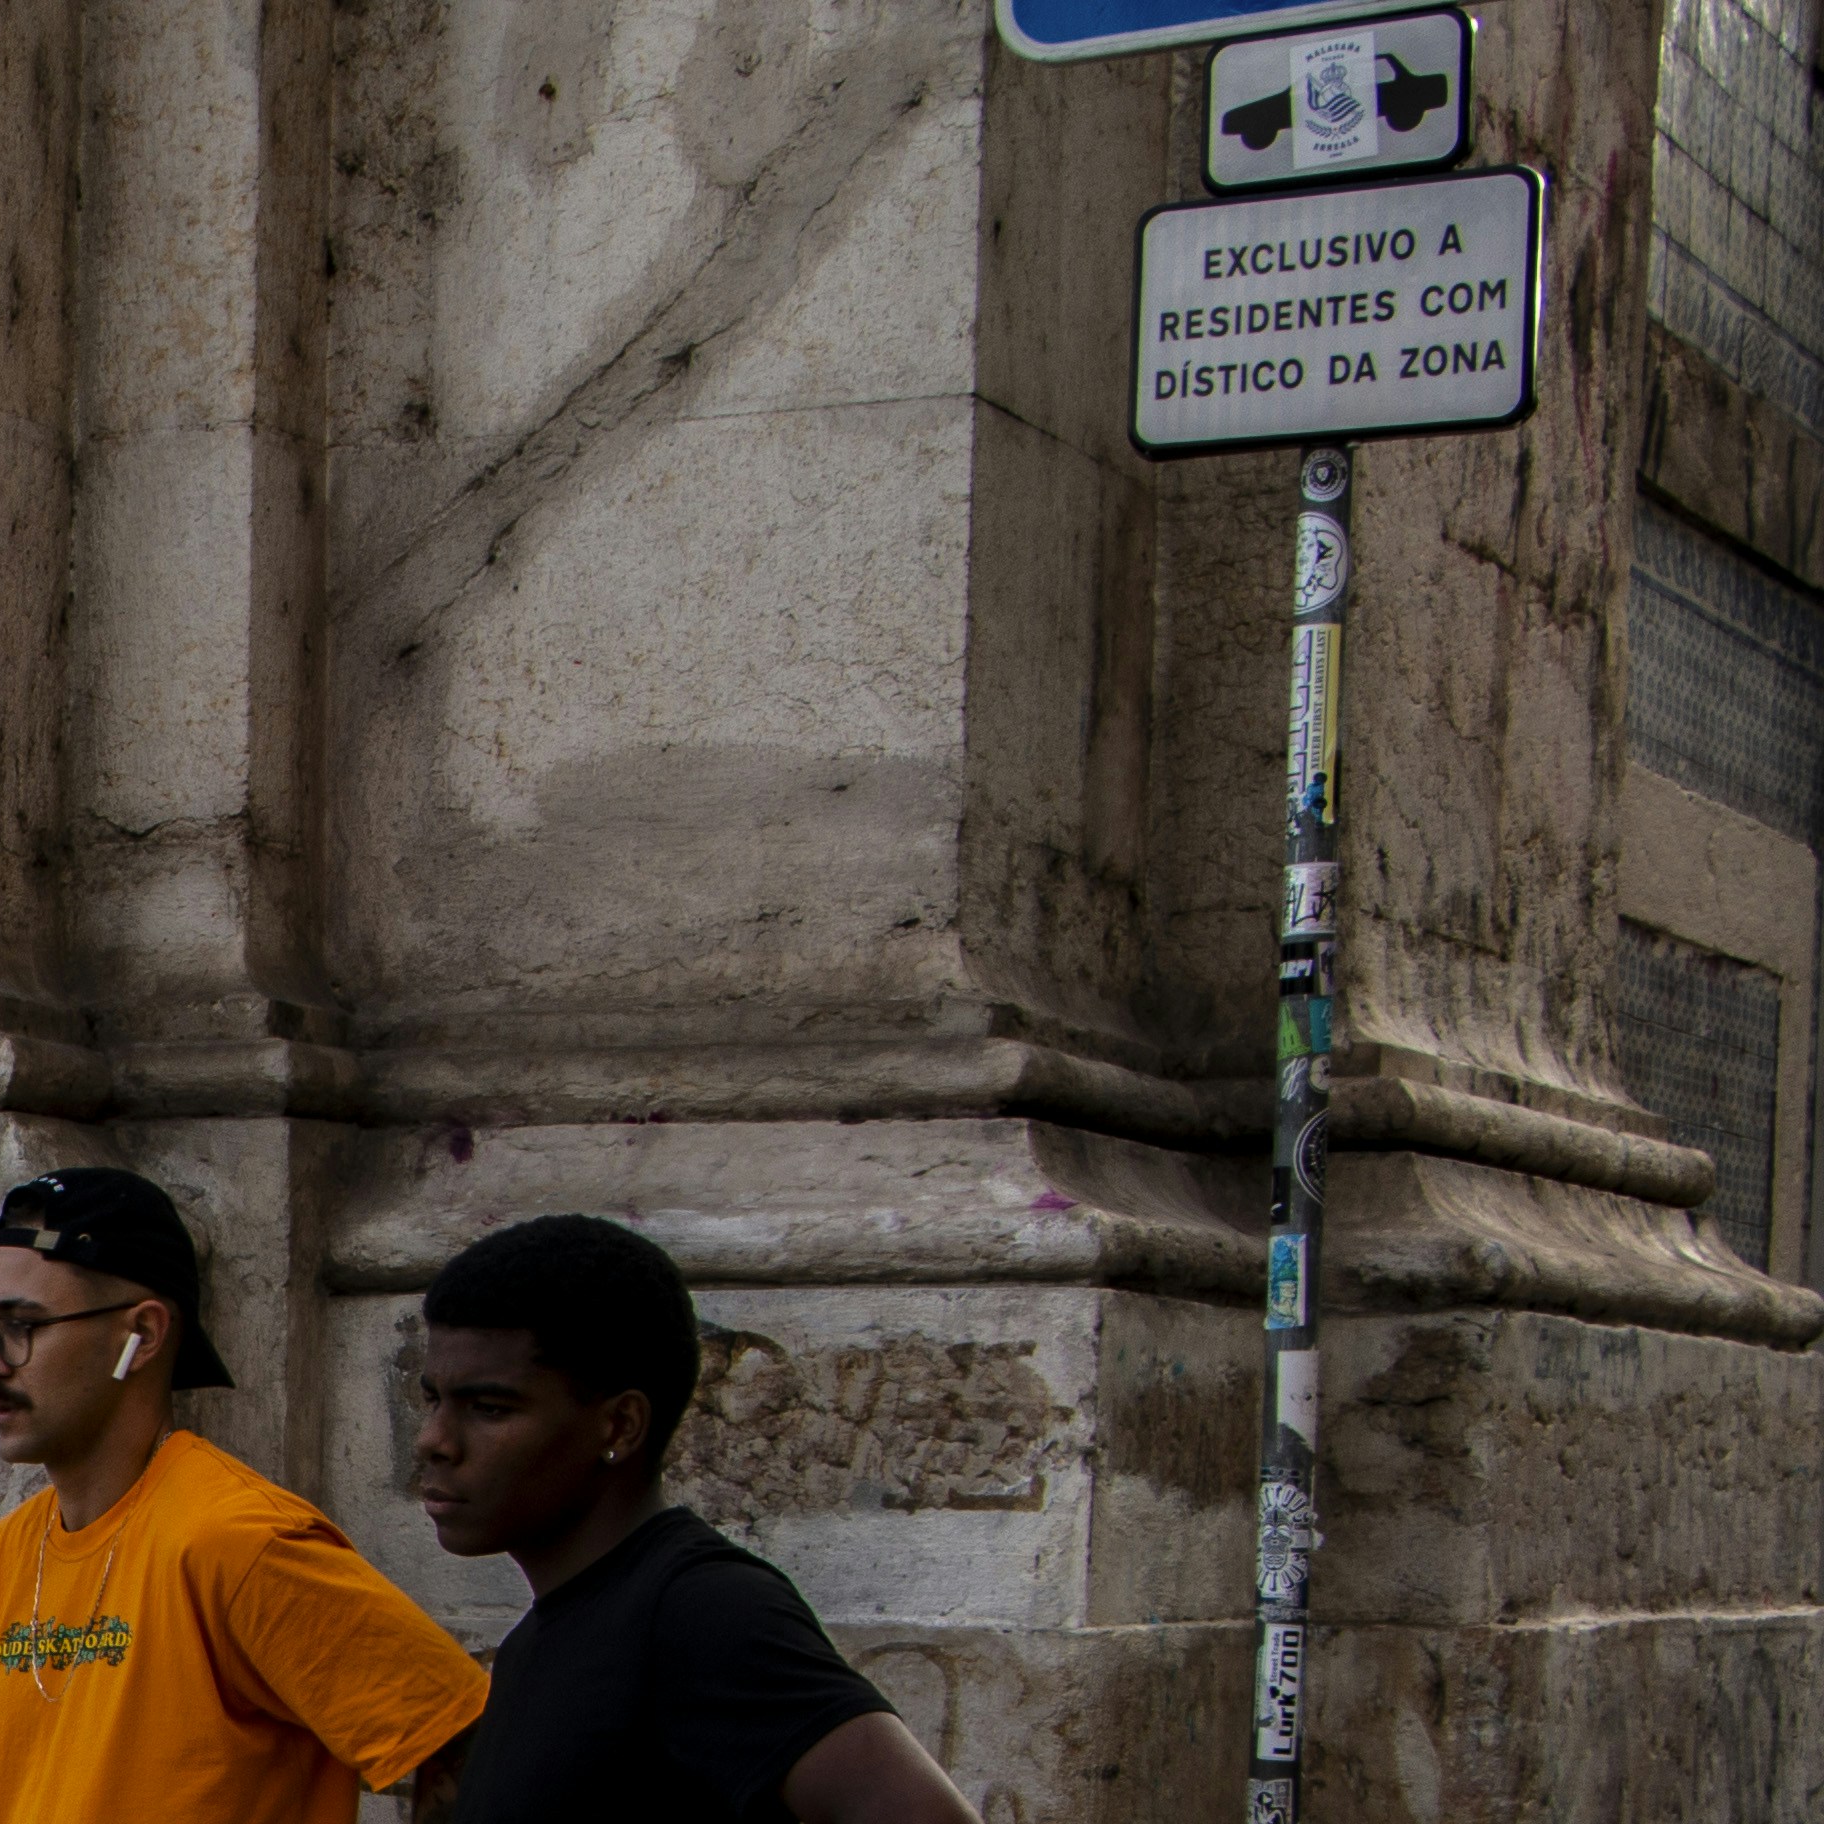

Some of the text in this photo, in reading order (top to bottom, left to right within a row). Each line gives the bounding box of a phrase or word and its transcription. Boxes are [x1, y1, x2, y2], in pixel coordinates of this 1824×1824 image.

[1203, 223, 1463, 281] EXCLUSIVO A
[1158, 279, 1508, 343] RESIDENTES COM
[1155, 340, 1506, 401] DÍSTICO DA ZONA
[1315, 630, 1326, 655] LAST
[1314, 657, 1325, 697] ALWAYS
[1269, 1657, 1278, 1683] Street
[1272, 1629, 1300, 1756] Lurk 700
